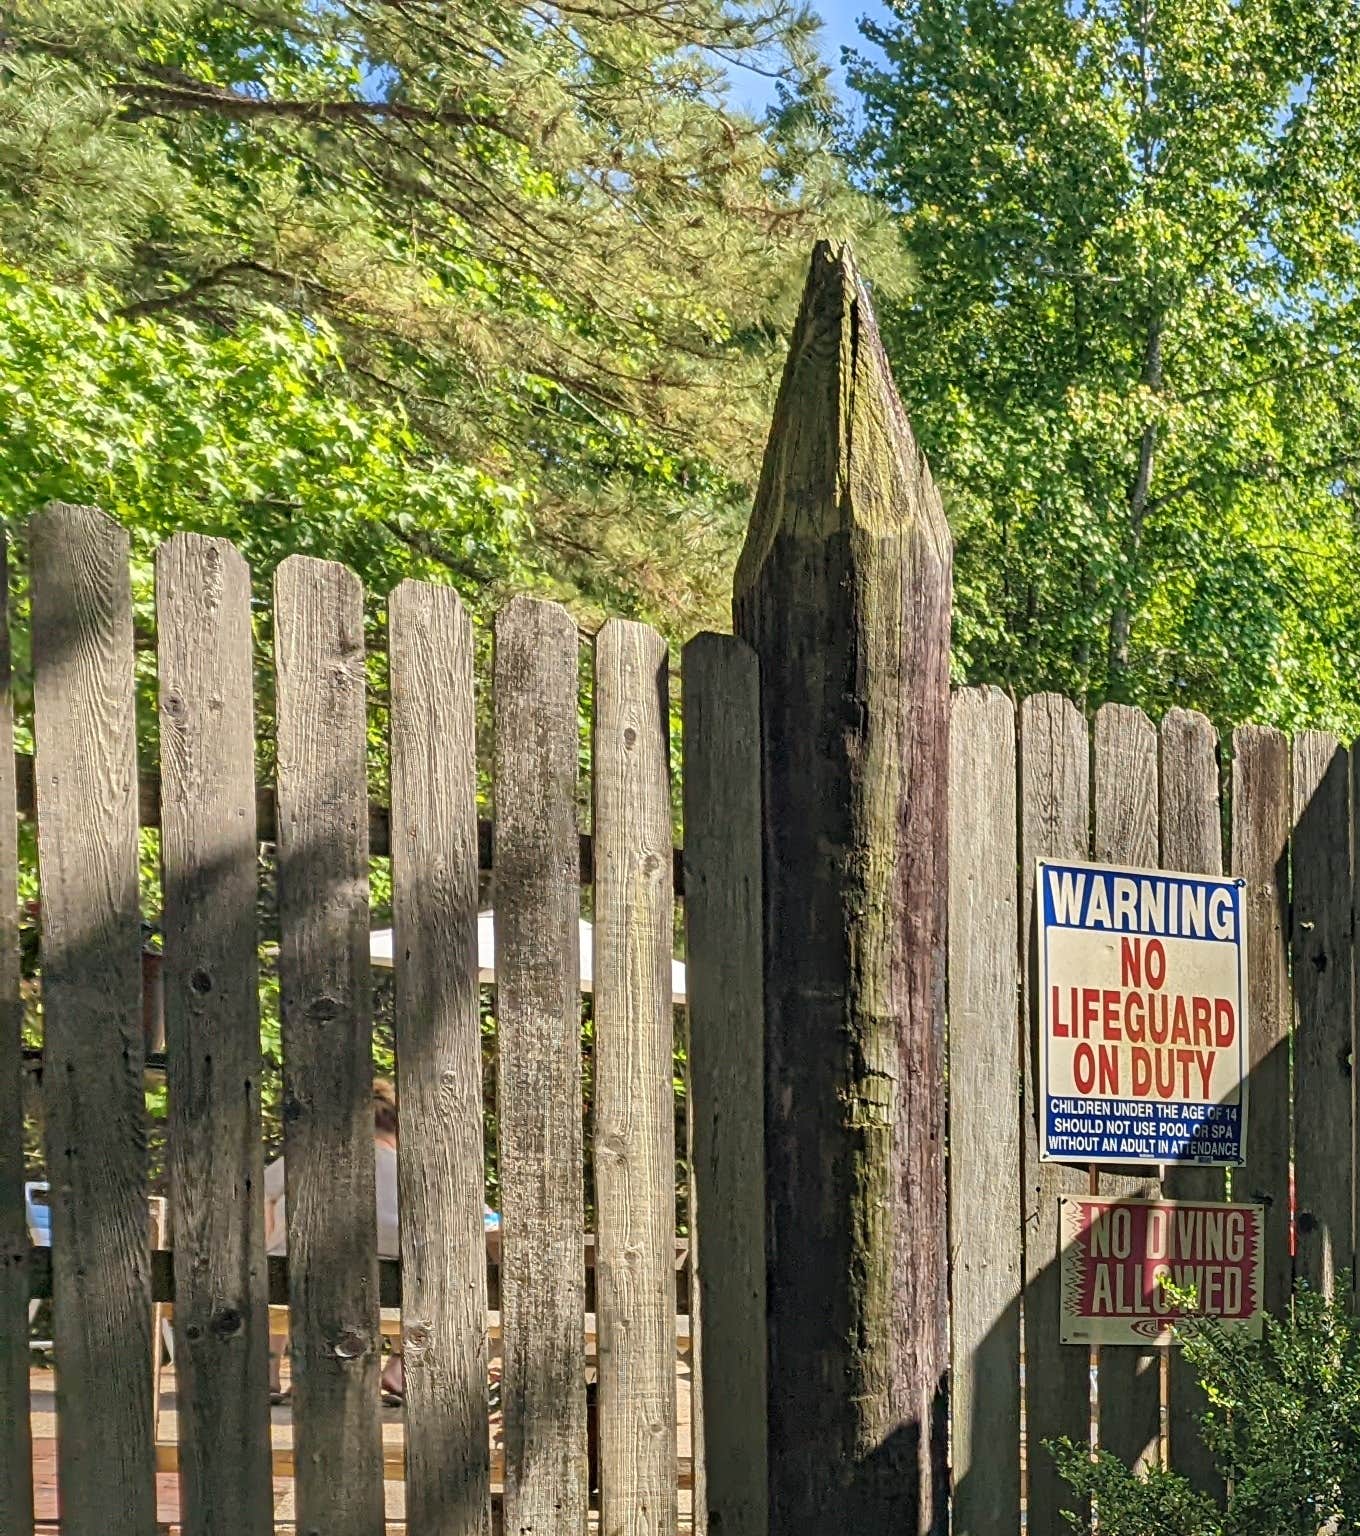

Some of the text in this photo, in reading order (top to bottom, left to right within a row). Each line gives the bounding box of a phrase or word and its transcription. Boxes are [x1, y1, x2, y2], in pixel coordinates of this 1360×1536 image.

[1048, 870, 1235, 941] WARNING
[1120, 936, 1167, 990] NO
[1052, 986, 1235, 1048] LIFEGUARD
[1073, 1042, 1216, 1100] ON DUTY
[1050, 1099, 1237, 1122] CHILDREN UNDER THE AGE OF 14
[1054, 1118, 1233, 1139] SHOULD NOT USE POOL OR SPA
[1048, 1135, 1238, 1156] WITHOUT AN ADULT IN ATTENDANCE
[1090, 1206, 1245, 1263] NO DIVING
[1091, 1263, 1243, 1315] ALLOWED
